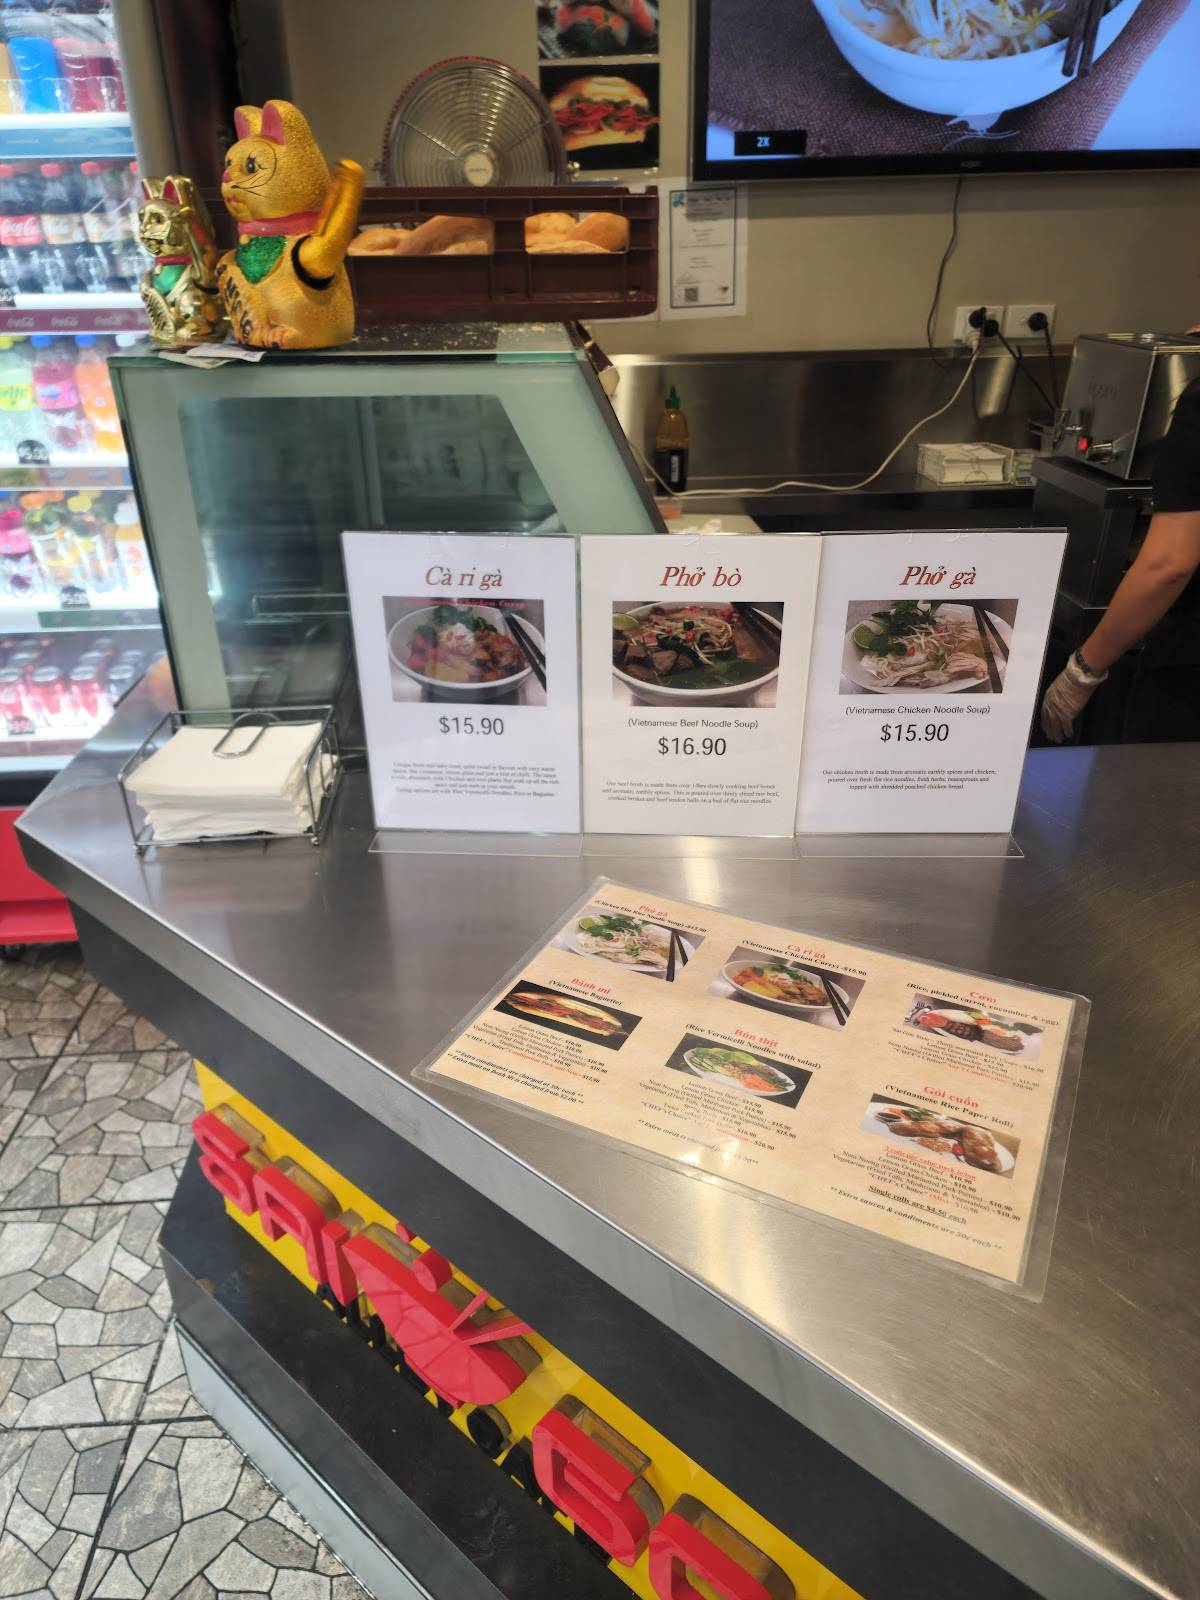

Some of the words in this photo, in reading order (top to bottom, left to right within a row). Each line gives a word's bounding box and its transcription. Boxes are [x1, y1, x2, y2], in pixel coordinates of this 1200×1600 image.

[756, 136, 770, 147] 2X
[425, 566, 453, 587] Cà
[458, 566, 474, 587] ri
[480, 568, 504, 591] gà
[660, 565, 706, 587] Phở
[712, 565, 742, 587] bò
[899, 565, 947, 586] Phở
[949, 566, 976, 590] gà
[845, 705, 895, 716] (Vietnamese
[897, 704, 931, 714] Chicken
[933, 704, 964, 714] Noodle
[965, 704, 991, 715] Soup)
[439, 715, 504, 736] $15.90
[628, 718, 678, 728] (Vietnamese
[680, 719, 699, 728] Beef
[701, 719, 732, 728] Noodle
[734, 719, 759, 729] Soup)
[880, 723, 950, 743] $15.90
[657, 736, 728, 756] $16.90
[784, 950, 813, 961] Chicken
[930, 988, 958, 1000] pickled
[989, 1004, 1028, 1018] cucumber
[684, 1023, 705, 1033] (Rice
[704, 1029, 745, 1045] Vermicelli
[745, 1041, 777, 1055] Noodles
[777, 1051, 796, 1061] with
[796, 1056, 822, 1069] salad)
[884, 1084, 938, 1105] (Vietnamese
[940, 1100, 960, 1111] Rice
[962, 1107, 988, 1120] Paper
[991, 1115, 1014, 1128] Roll)
[868, 1185, 892, 1198] Single
[892, 1193, 910, 1204] rolls
[911, 1200, 925, 1210] are
[893, 1209, 940, 1230] condiments
